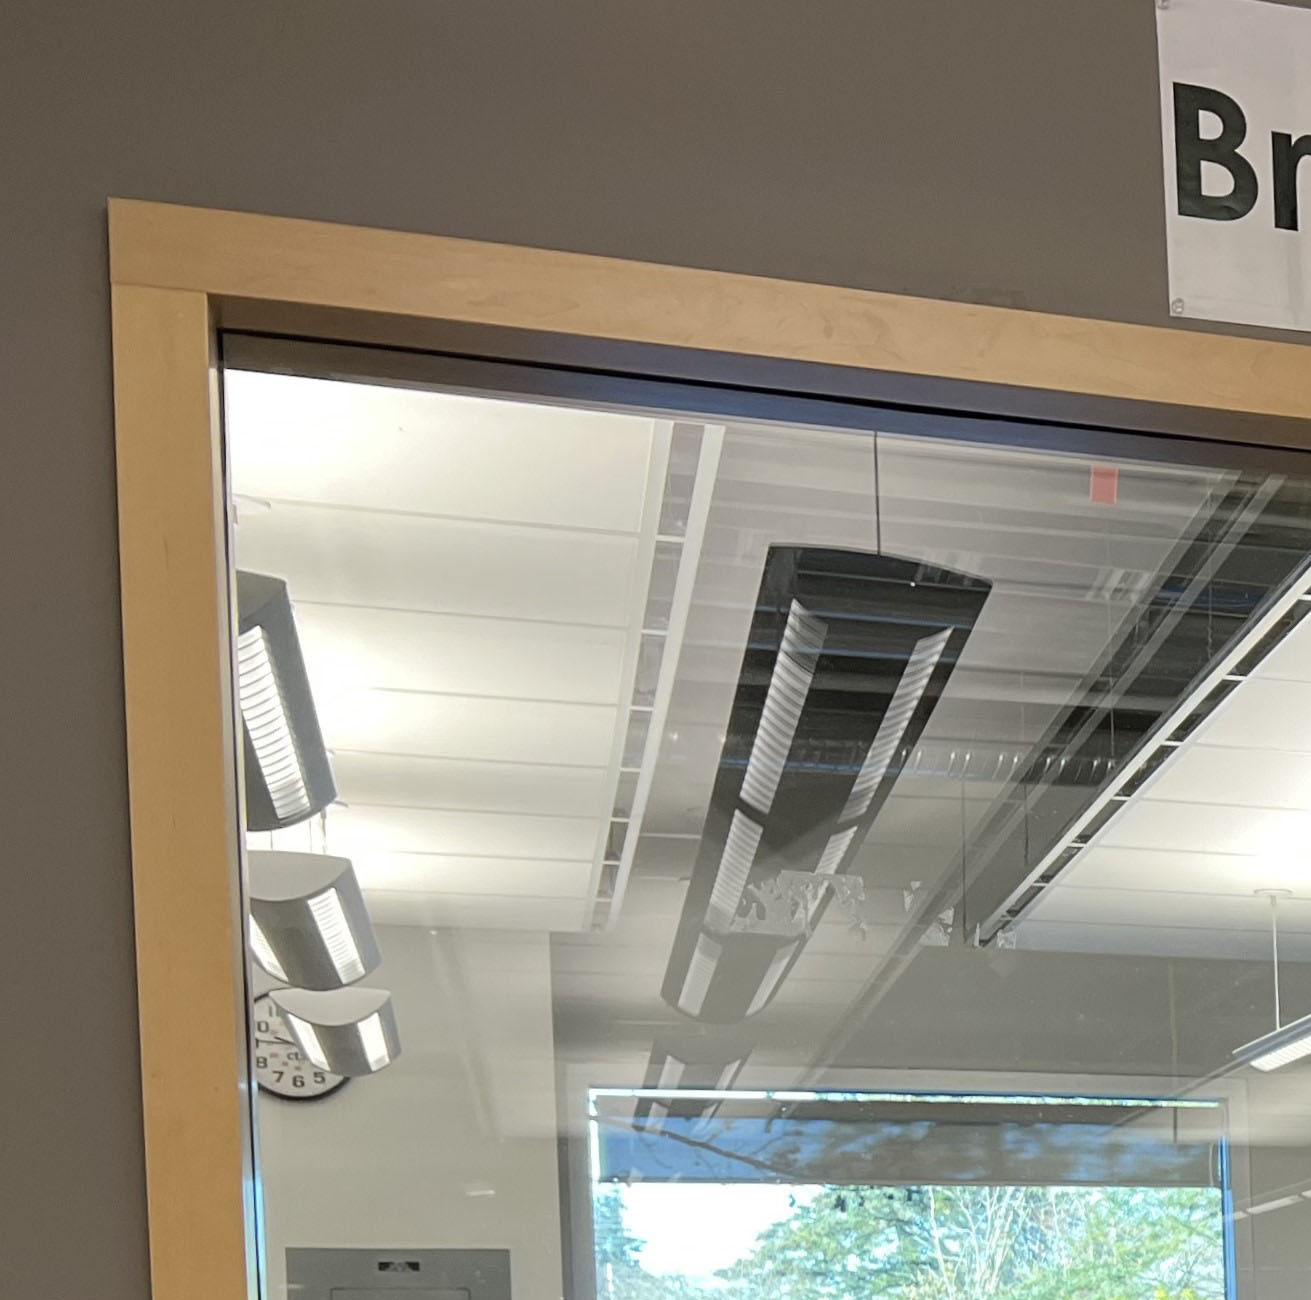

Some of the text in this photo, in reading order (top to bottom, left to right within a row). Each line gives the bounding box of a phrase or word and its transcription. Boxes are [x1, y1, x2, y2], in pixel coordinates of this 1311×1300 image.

[256, 1056, 267, 1068] 8
[273, 1072, 284, 1082] 7
[292, 1076, 304, 1088] 6
[314, 1072, 326, 1083] 5
